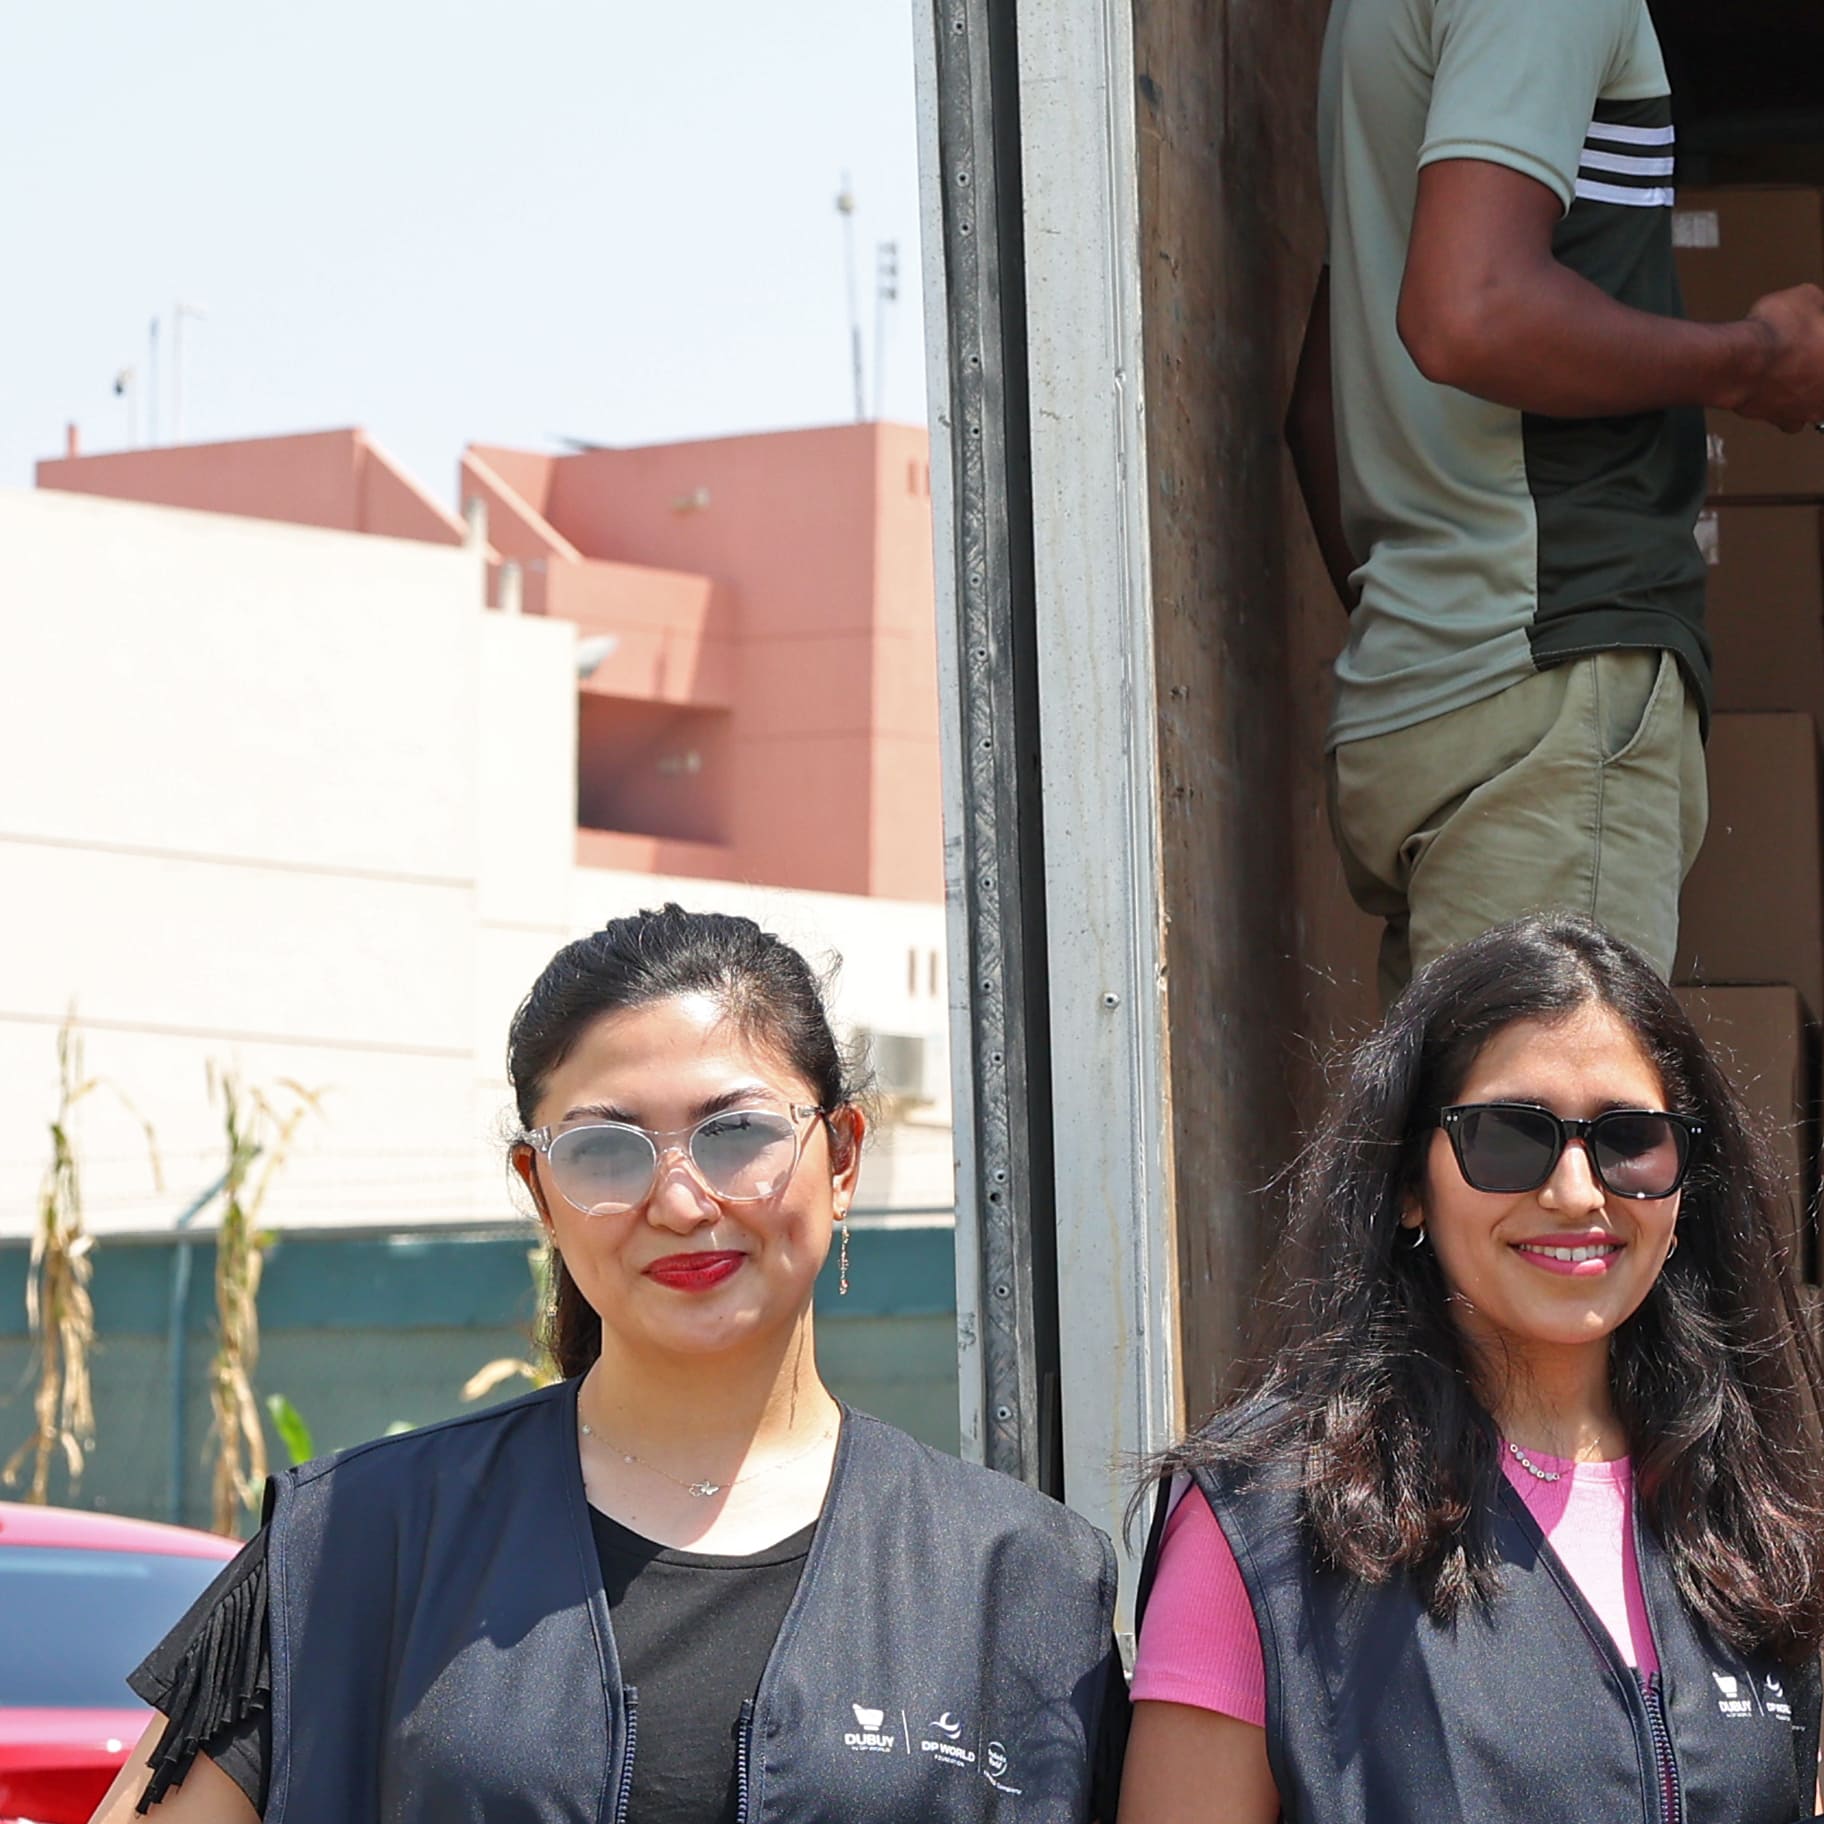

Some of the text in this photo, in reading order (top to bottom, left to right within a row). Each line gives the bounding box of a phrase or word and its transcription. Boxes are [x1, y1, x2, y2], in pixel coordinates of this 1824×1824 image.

[1718, 1700, 1752, 1712] DUBUY
[844, 1733, 894, 1747] DUBUY
[921, 1741, 939, 1751] DP
[939, 1743, 976, 1763] WORLD
